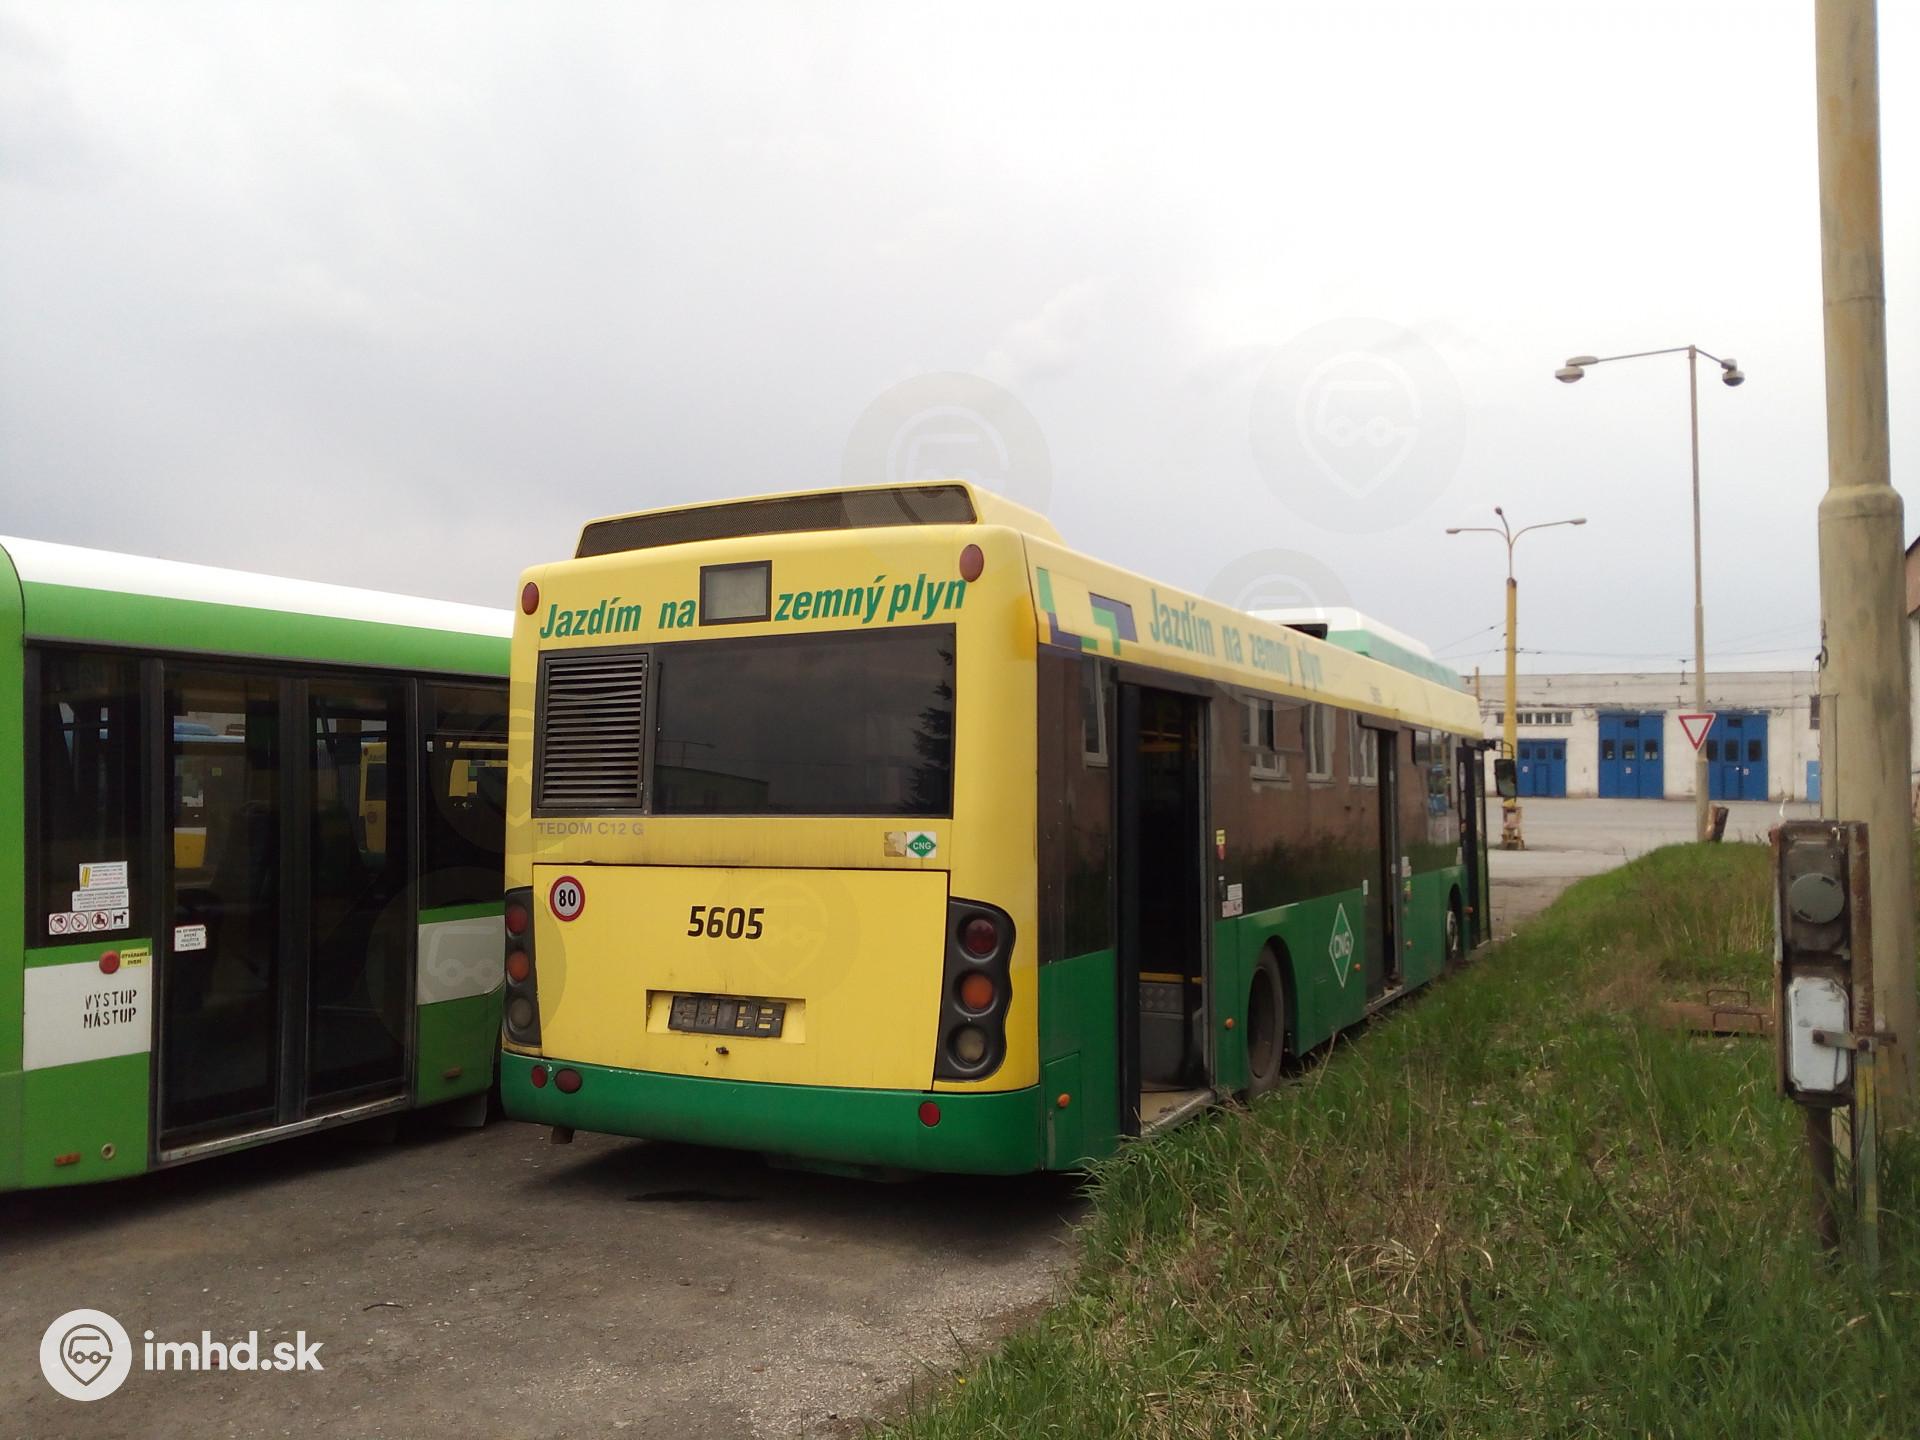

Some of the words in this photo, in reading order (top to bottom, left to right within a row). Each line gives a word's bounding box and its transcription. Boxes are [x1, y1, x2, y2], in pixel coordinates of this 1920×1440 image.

[539, 597, 642, 639] Jazdím
[658, 600, 697, 629] na
[774, 575, 887, 624] zemný
[887, 573, 967, 622] plyn
[1149, 588, 1216, 657] Jazdím
[1222, 625, 1245, 664] na
[537, 822, 593, 835] TEDOM
[598, 822, 626, 835] C12
[632, 822, 645, 835] G
[912, 841, 932, 850] CNG
[558, 889, 577, 907] 80
[687, 905, 765, 940] 5605
[1334, 931, 1350, 959] CNG
